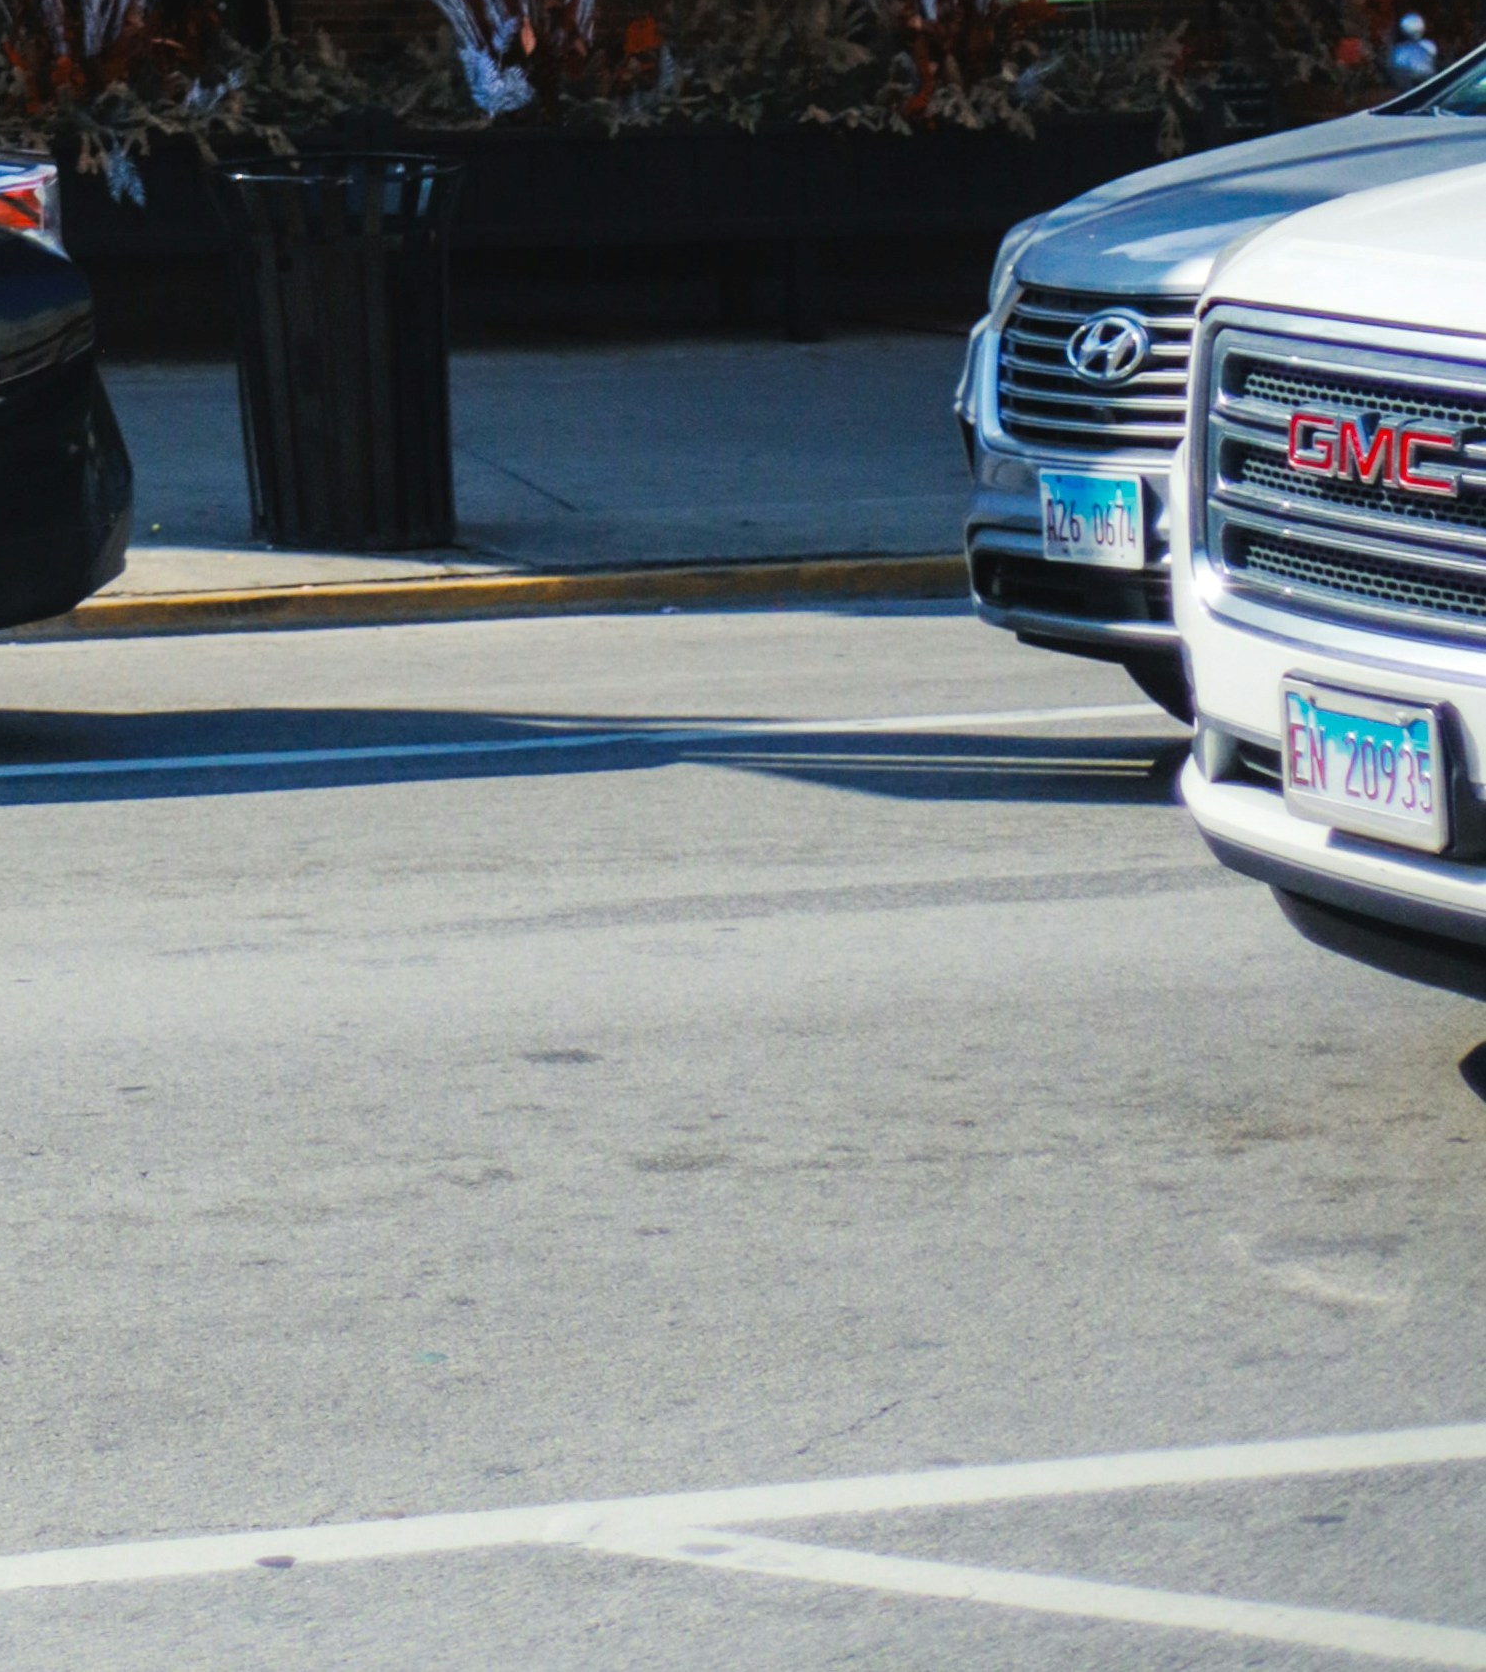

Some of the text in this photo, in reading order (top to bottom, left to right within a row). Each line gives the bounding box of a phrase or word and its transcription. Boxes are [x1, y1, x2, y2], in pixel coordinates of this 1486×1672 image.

[1288, 411, 1460, 496] GMC
[1046, 497, 1137, 549] A26 0674
[1289, 721, 1433, 814] EN 20935
